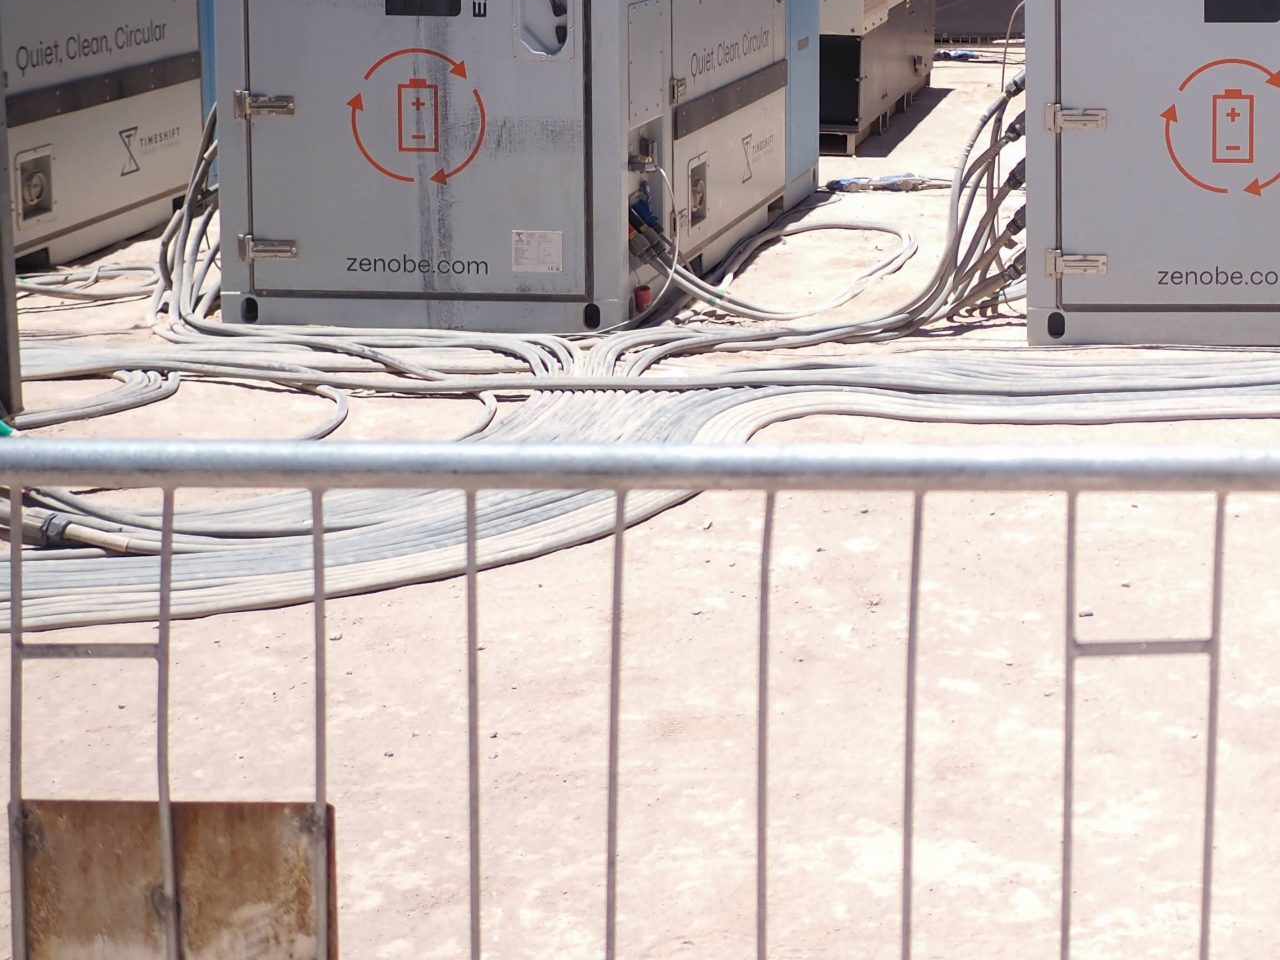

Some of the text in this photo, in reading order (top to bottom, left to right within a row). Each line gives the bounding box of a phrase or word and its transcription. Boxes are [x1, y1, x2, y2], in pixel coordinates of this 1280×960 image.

[16, 20, 167, 77] Quiet, Clean, Circular
[742, 26, 770, 56] Circular
[346, 255, 489, 276] zenobe.com
